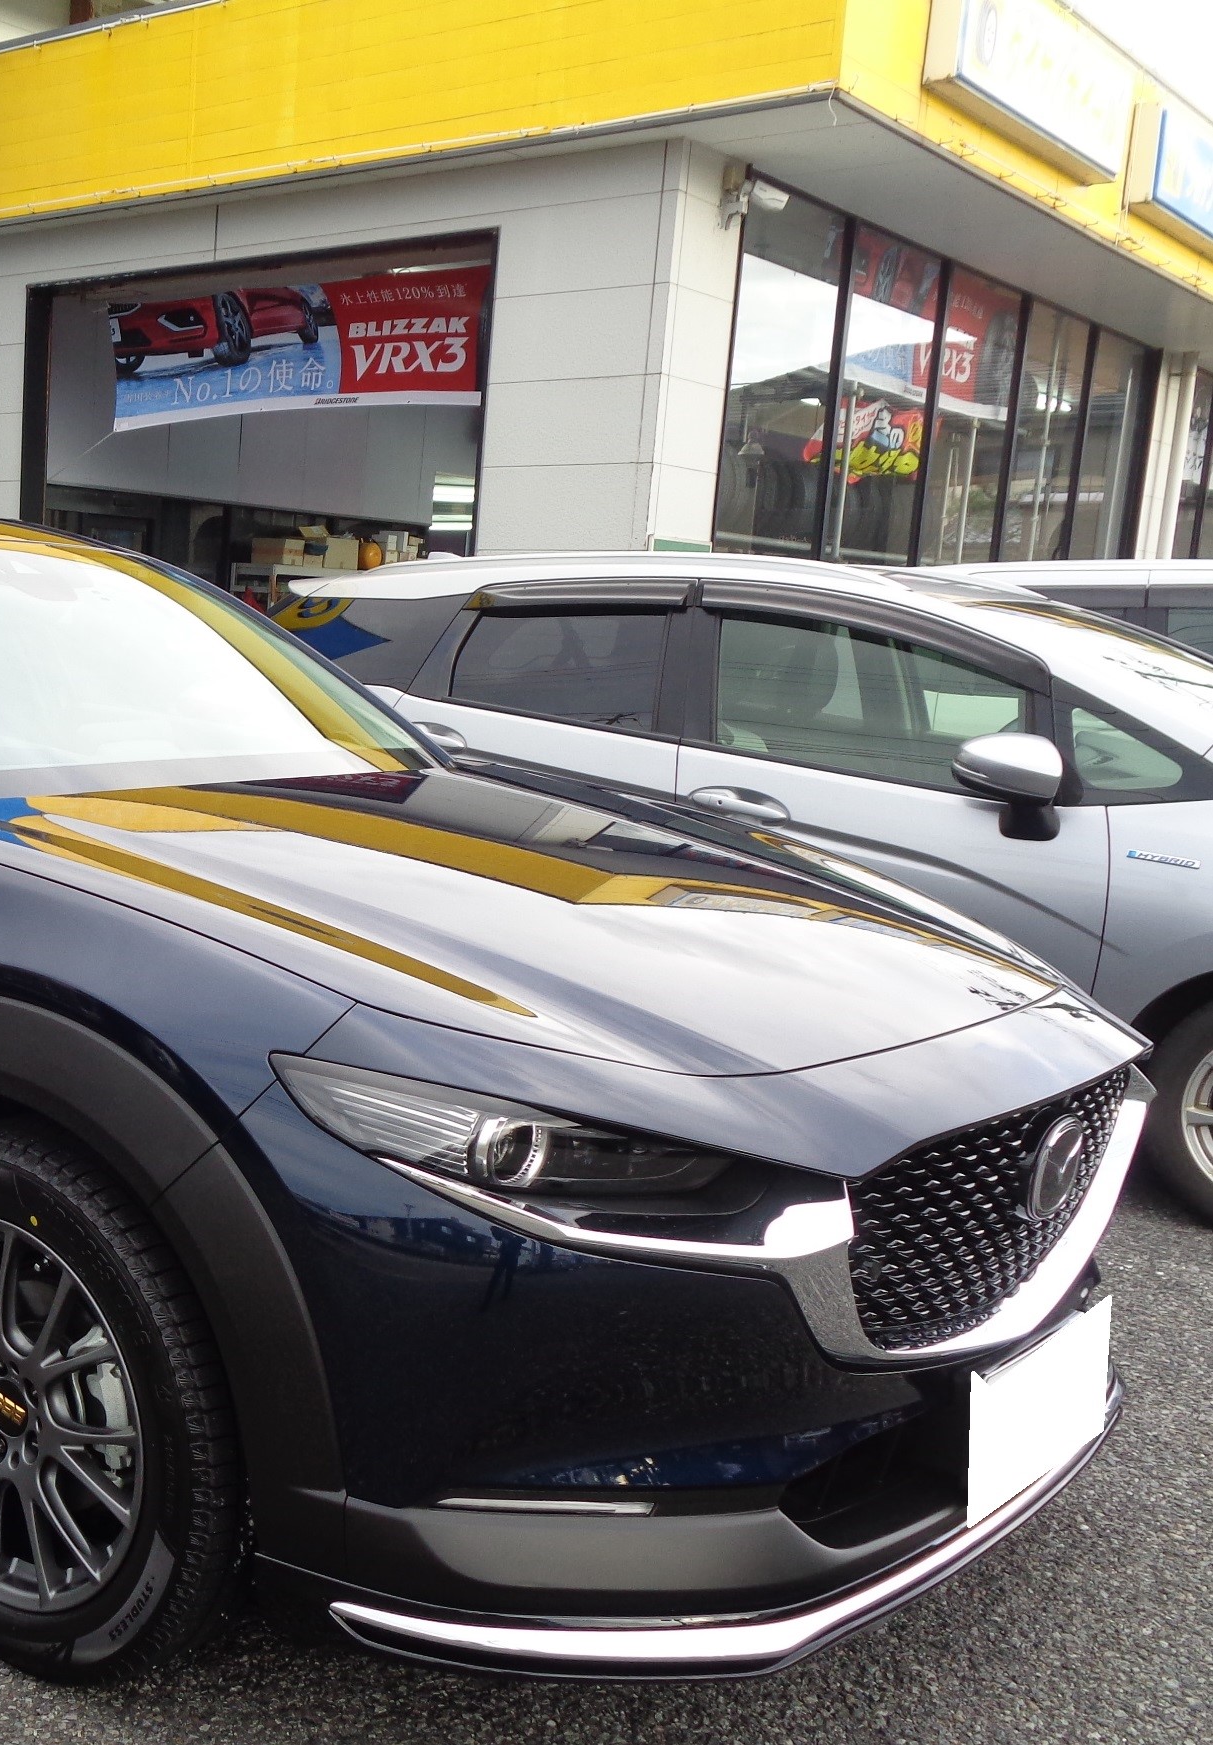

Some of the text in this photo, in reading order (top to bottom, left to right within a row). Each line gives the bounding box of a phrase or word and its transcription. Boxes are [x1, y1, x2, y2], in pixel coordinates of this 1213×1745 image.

[349, 317, 469, 338] BLIZZAK
[349, 337, 469, 382] VRX3
[1137, 852, 1196, 868] HYBRID
[108, 1580, 155, 1642] STUDLESS
